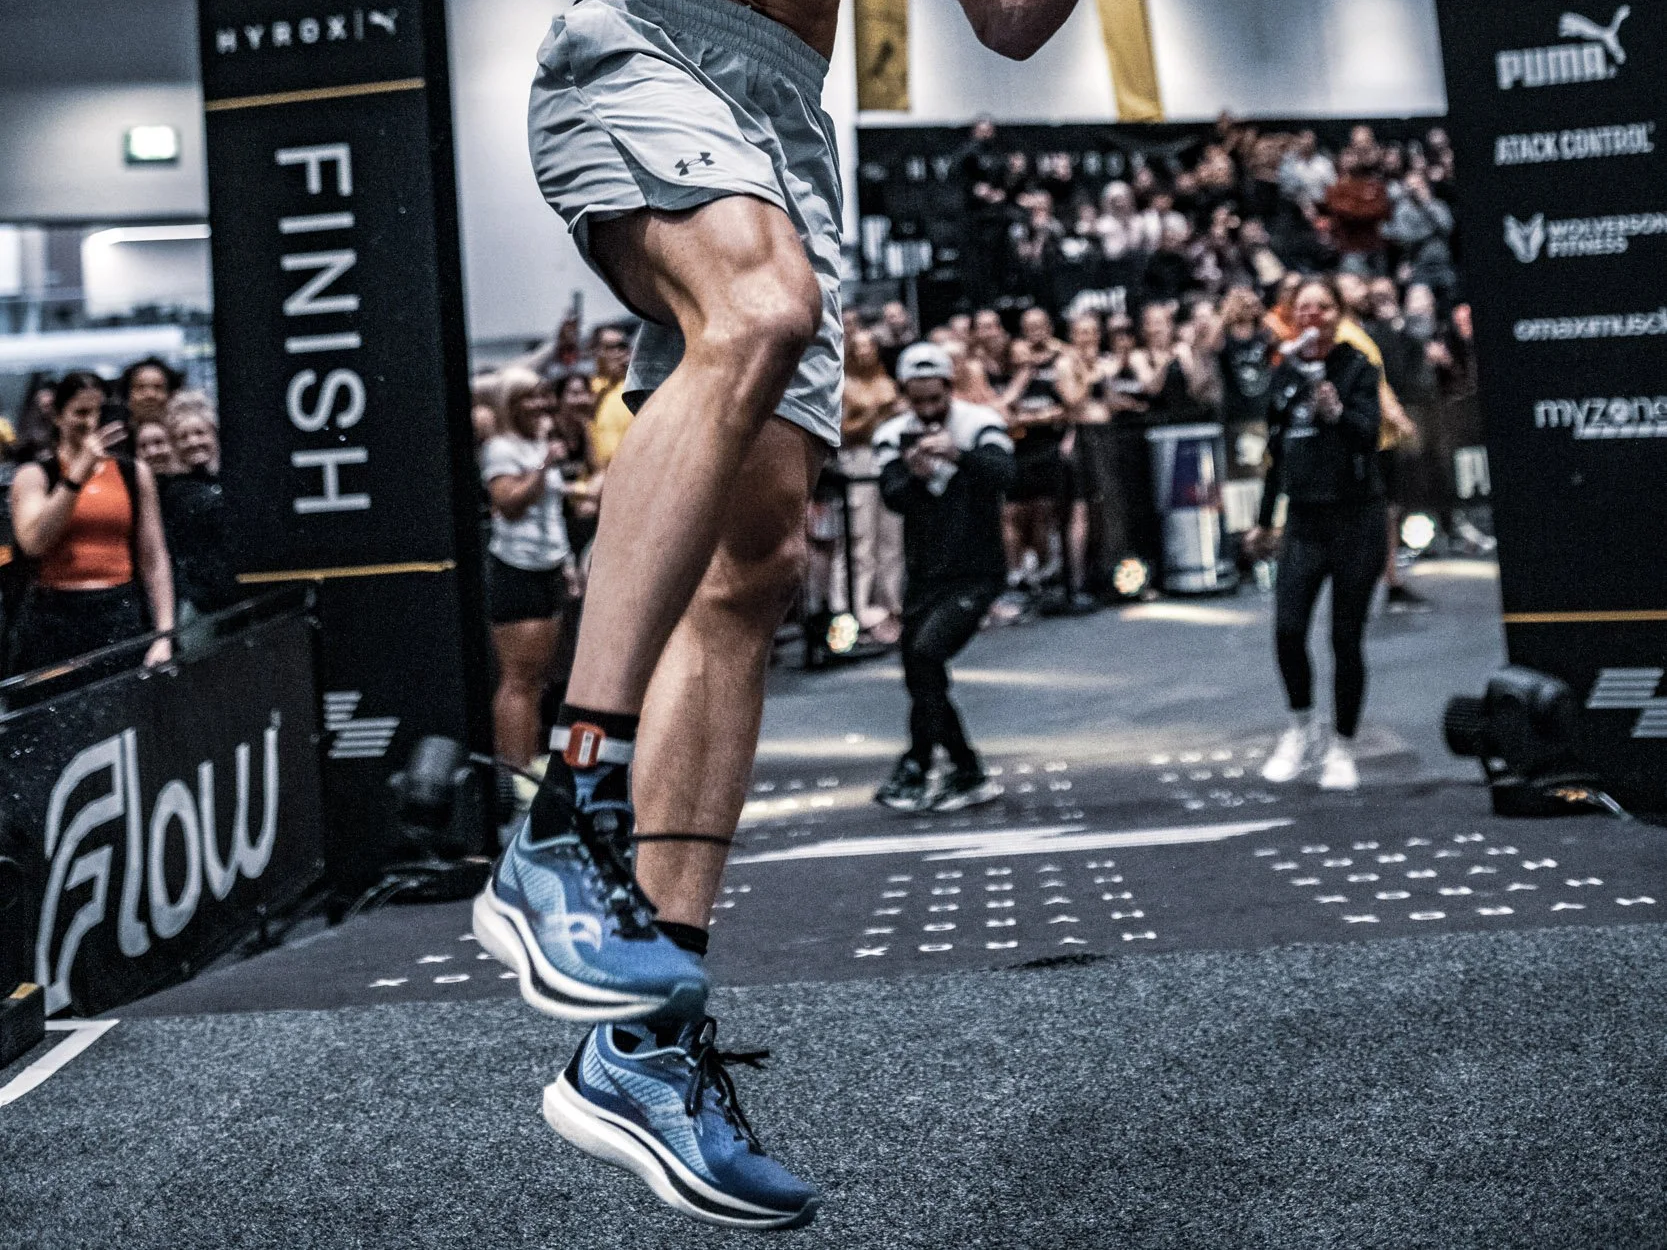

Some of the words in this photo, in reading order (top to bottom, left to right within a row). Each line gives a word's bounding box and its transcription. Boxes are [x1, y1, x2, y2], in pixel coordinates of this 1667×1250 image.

[215, 14, 348, 54] HYROX
[1559, 122, 1655, 160] CONTROL
[274, 142, 372, 514] FINISH
